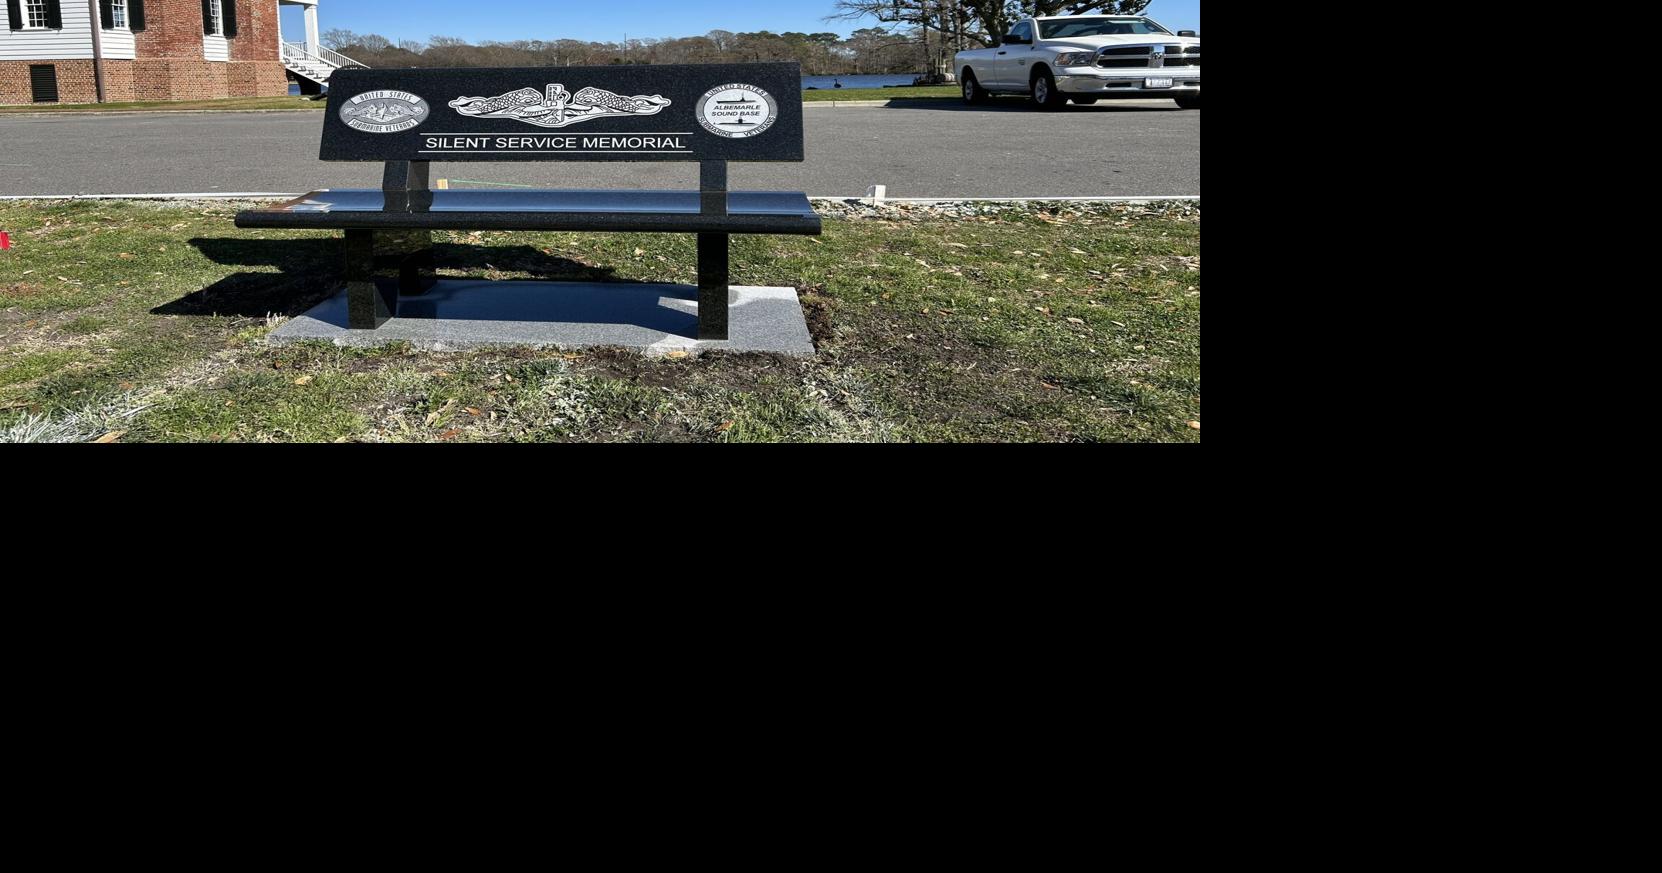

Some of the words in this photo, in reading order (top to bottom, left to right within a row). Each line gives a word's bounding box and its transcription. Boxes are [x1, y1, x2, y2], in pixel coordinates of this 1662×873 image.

[359, 91, 384, 101] UNITED
[389, 91, 412, 101] STATES
[708, 84, 735, 96] UNITED
[736, 84, 767, 96] STATES
[351, 120, 382, 132] SUBMARINE
[385, 120, 415, 132] VETERANS
[700, 117, 733, 137] SUBMARINE
[743, 116, 776, 137] VETERANS
[425, 137, 492, 149] SILENT
[495, 137, 577, 149] SERVICE
[582, 137, 686, 149] MEMORIAL
